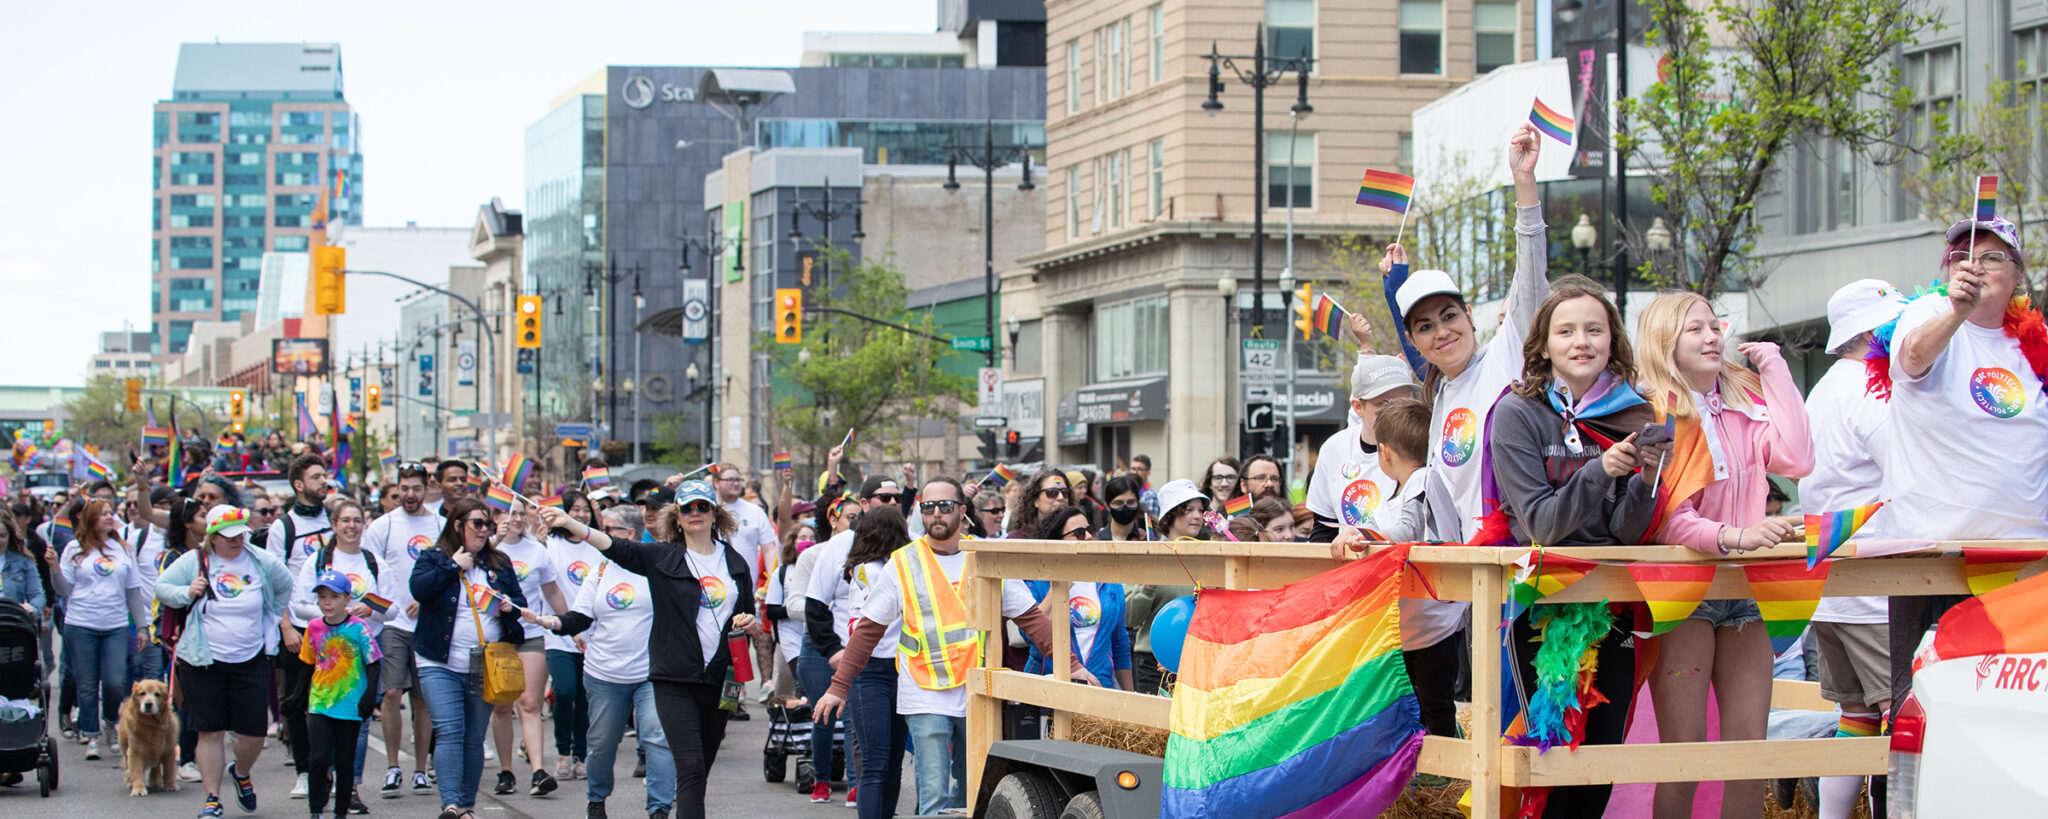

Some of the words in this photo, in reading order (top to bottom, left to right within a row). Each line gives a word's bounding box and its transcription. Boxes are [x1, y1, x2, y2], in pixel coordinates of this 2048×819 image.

[661, 83, 696, 101] Sta
[952, 337, 976, 348] Smith
[980, 338, 990, 349] St
[1247, 341, 1275, 349] Route
[1249, 353, 1273, 366] 42
[1273, 391, 1335, 407] inncial
[1344, 486, 1357, 502] RRC
[1995, 657, 2047, 691] RRC
